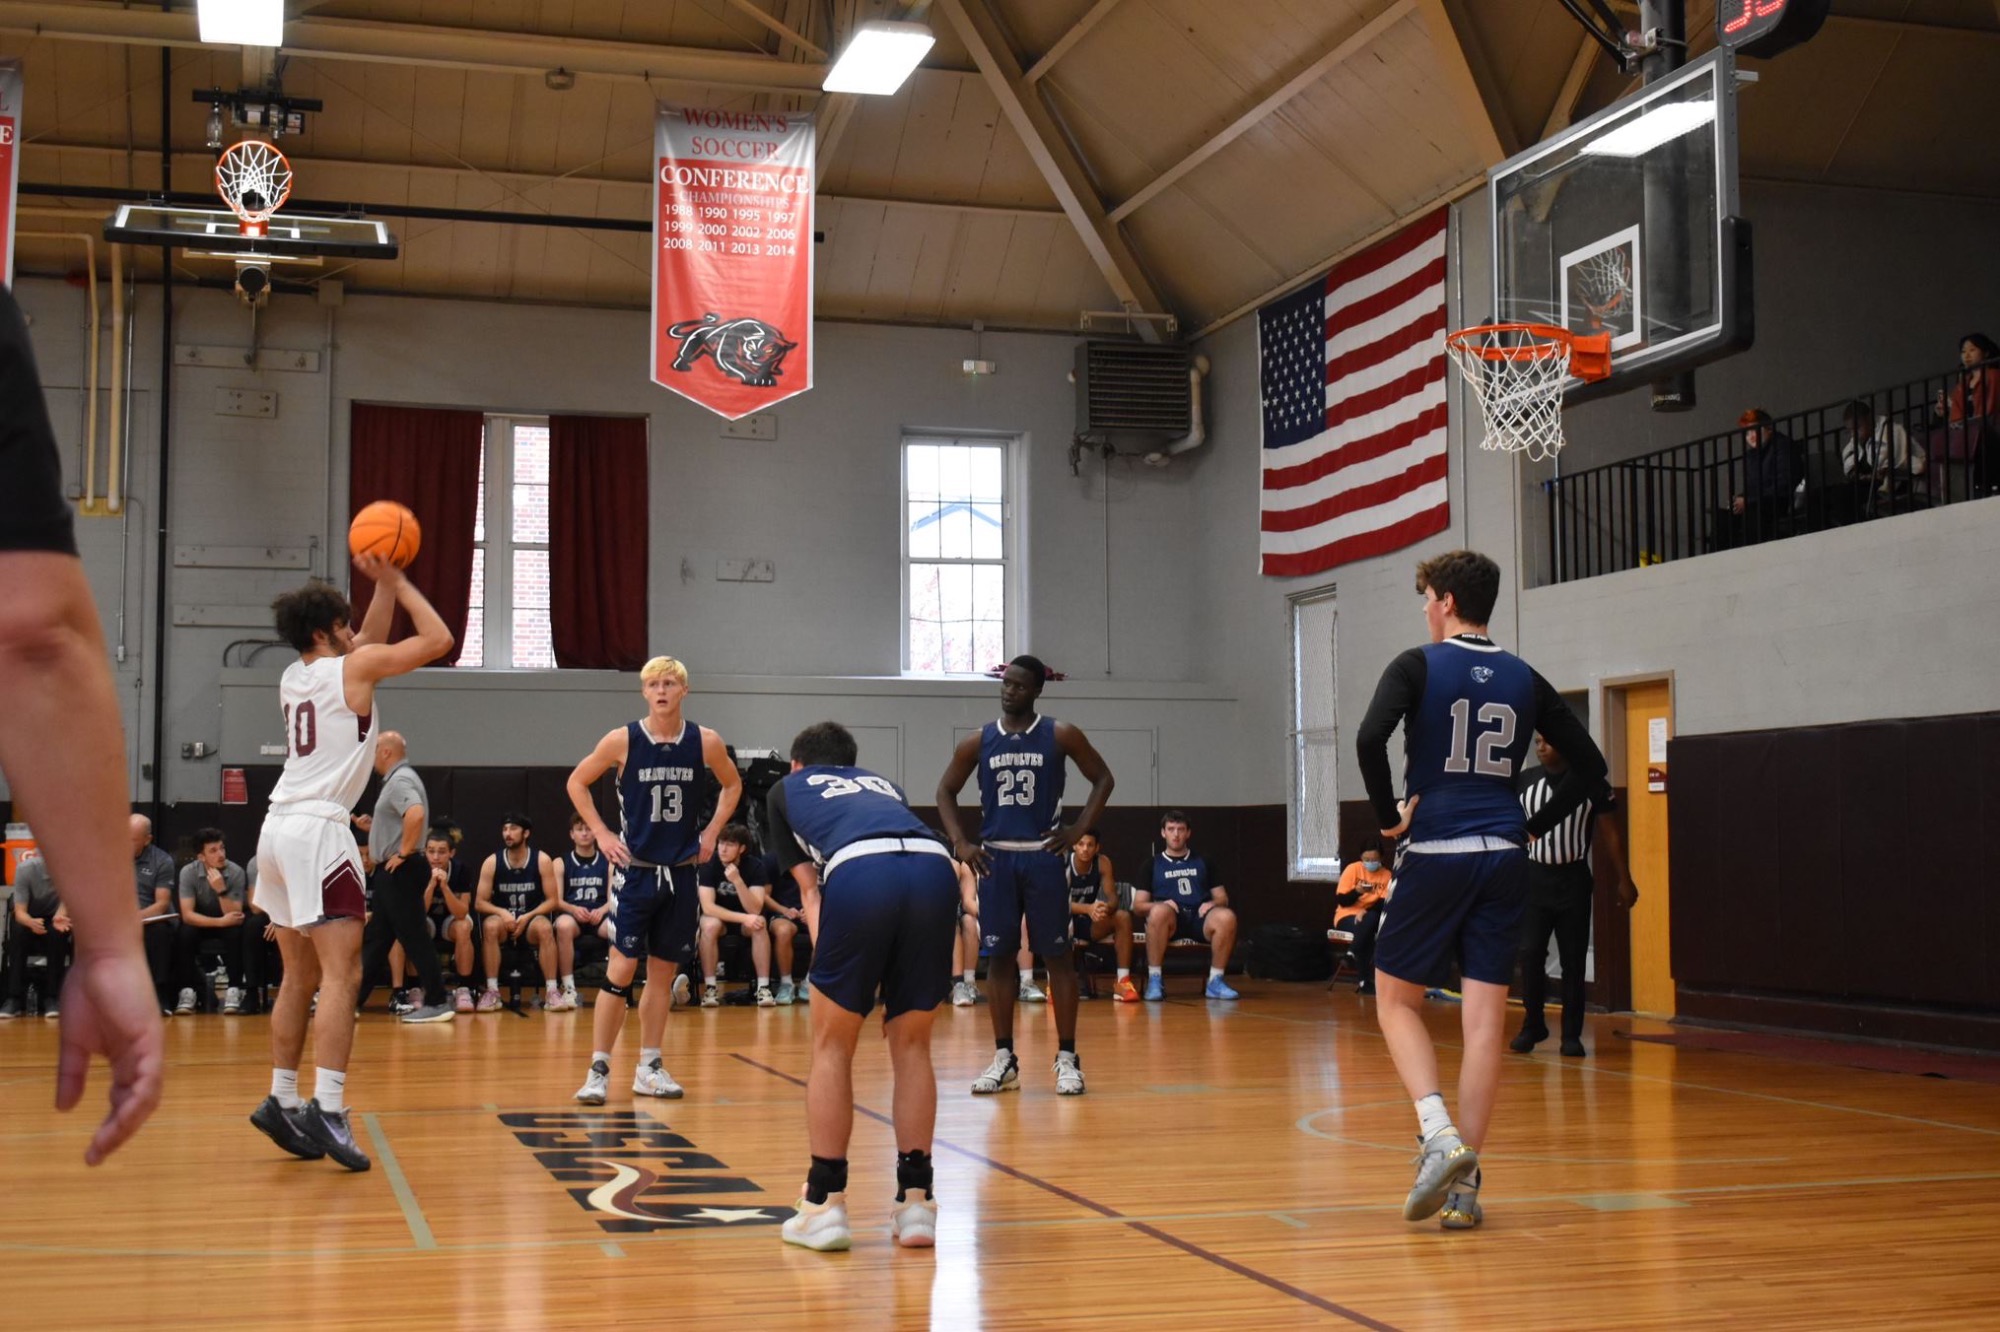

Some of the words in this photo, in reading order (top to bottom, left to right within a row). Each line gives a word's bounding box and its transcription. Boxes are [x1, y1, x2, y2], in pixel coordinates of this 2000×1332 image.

[683, 107, 787, 133] WOMEN'S
[692, 136, 780, 160] SOCCER
[660, 165, 809, 194] CONFERENCE
[680, 190, 789, 208] CHAMPIONSHIPS
[699, 207, 727, 219] 1990
[733, 209, 760, 221] 1995
[768, 211, 795, 224] 1997
[664, 221, 693, 233] 1999
[699, 224, 727, 236] 2000
[731, 225, 760, 238] 2002
[766, 228, 795, 240] 2006
[663, 237, 693, 249] 2008
[699, 240, 725, 252] 2011
[731, 242, 760, 255] 2013
[766, 244, 796, 256] 2014
[1444, 698, 1517, 777] 12
[989, 753, 1043, 769] SEAWOLVES
[638, 766, 694, 782] SEAWOLVES
[996, 769, 1035, 806] 23
[650, 784, 683, 823] 13
[1177, 877, 1192, 895] 0
